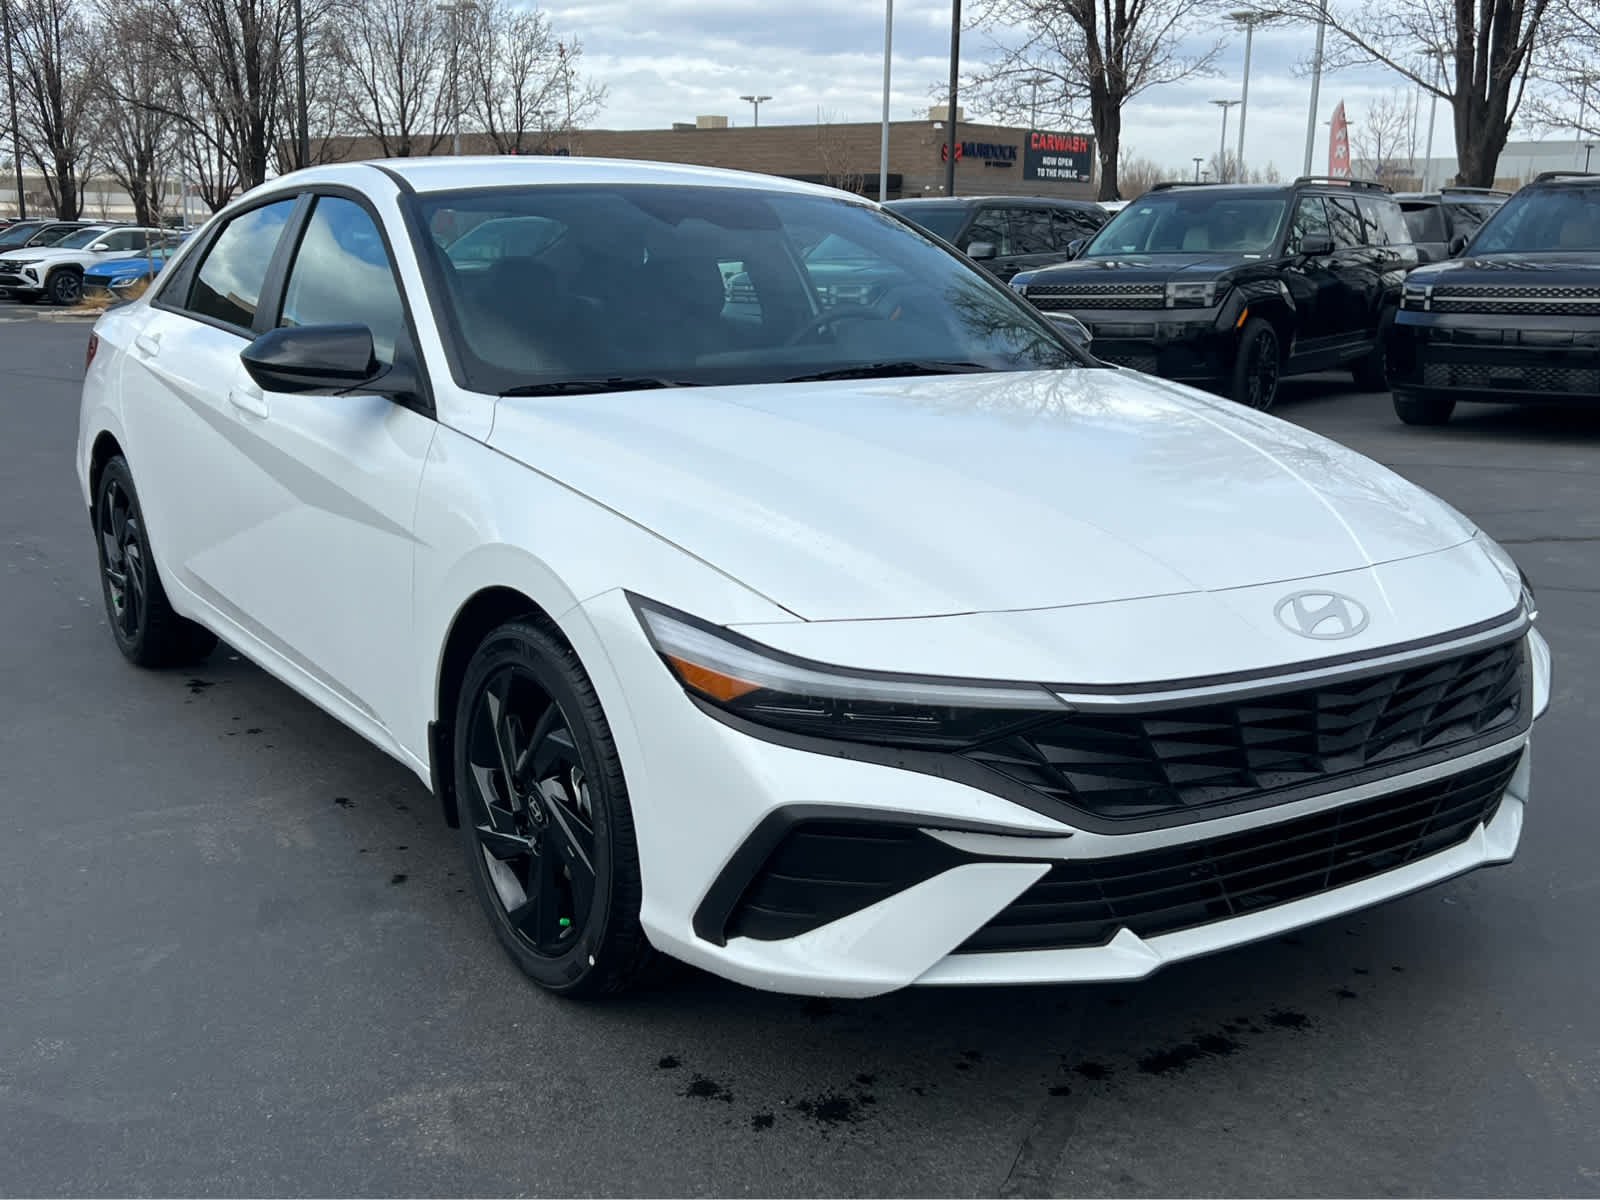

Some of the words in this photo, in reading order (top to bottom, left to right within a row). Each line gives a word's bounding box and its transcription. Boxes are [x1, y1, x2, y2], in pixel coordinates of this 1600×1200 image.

[1031, 132, 1087, 152] CARWASH
[1042, 156, 1057, 166] NOW
[1057, 157, 1073, 167] OPEN
[1037, 167, 1046, 177] TO
[1045, 168, 1057, 178] THE
[1057, 169, 1078, 179] PUBLIC
